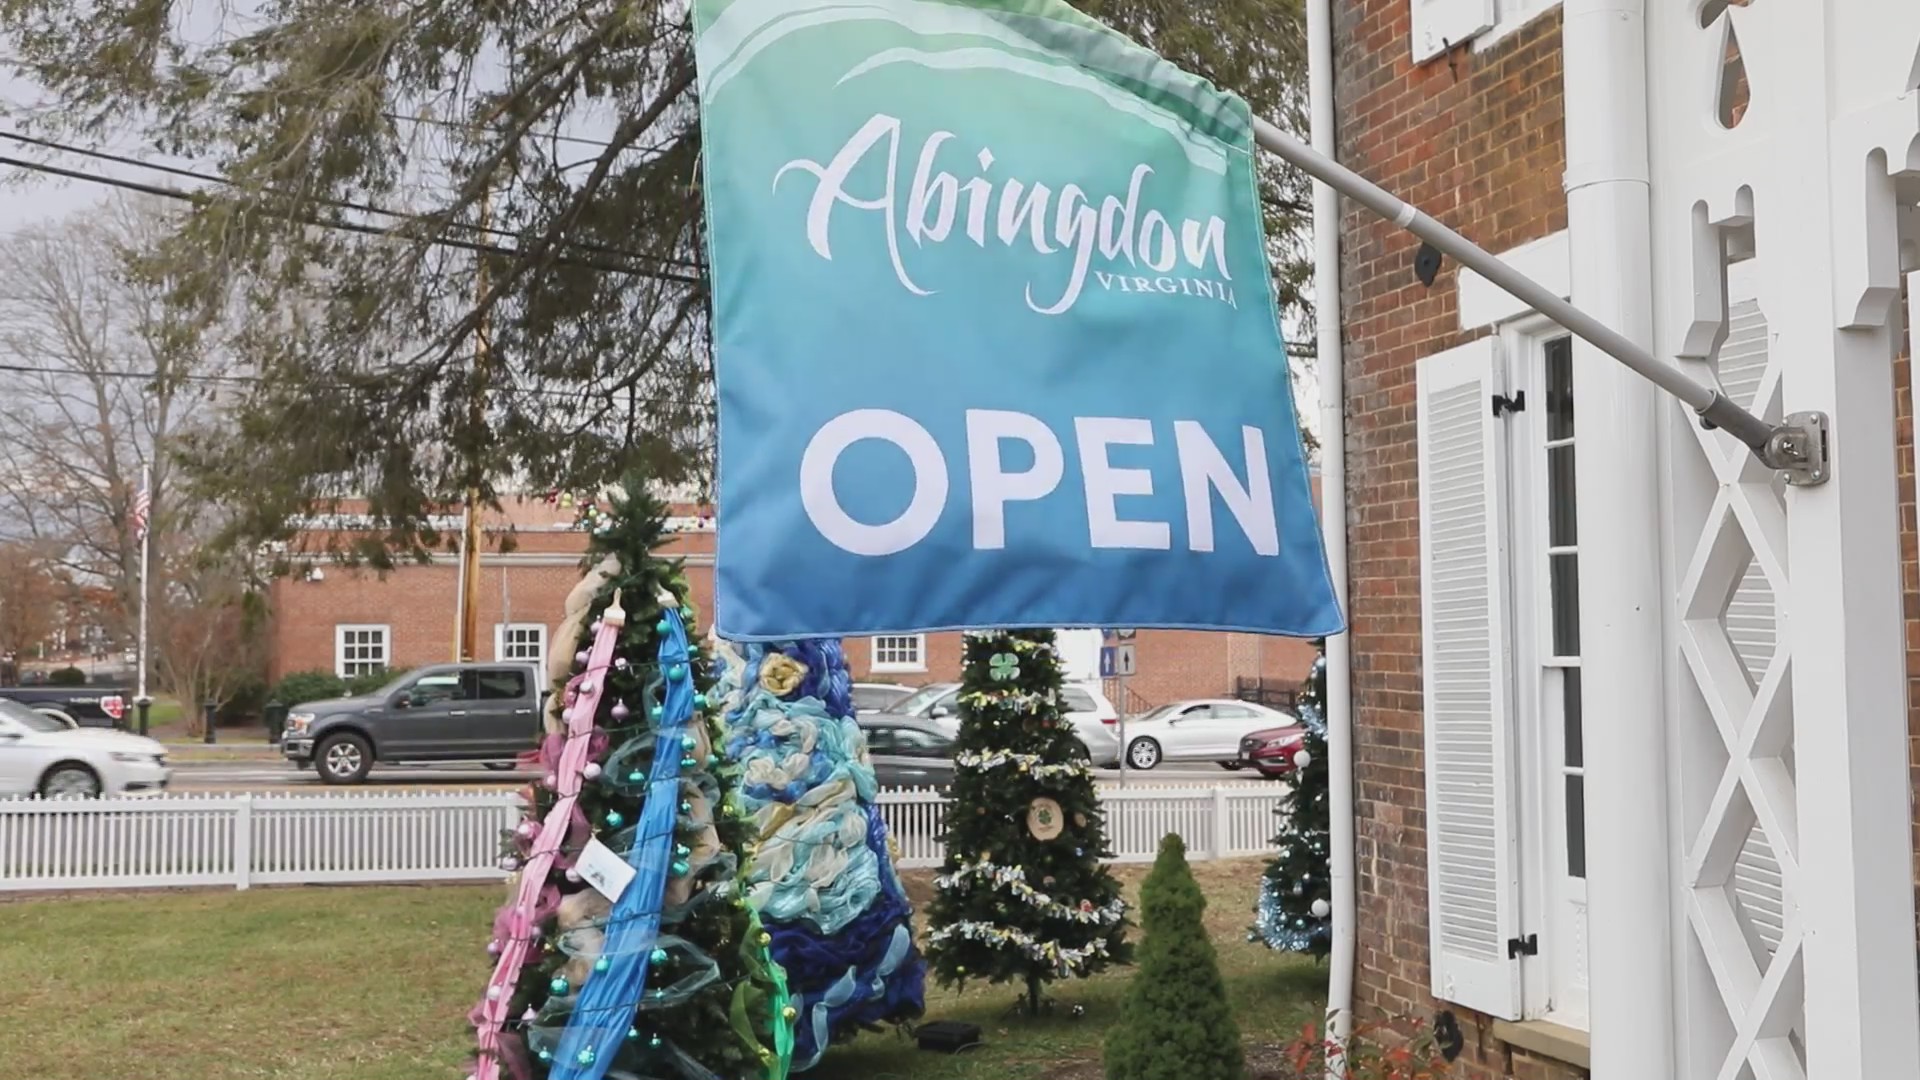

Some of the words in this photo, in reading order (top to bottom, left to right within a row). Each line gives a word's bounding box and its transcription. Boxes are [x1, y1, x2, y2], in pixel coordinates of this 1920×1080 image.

[773, 113, 1232, 314] Abingdon
[1094, 271, 1237, 310] VIRGINIA
[800, 408, 1280, 556] OPEN
